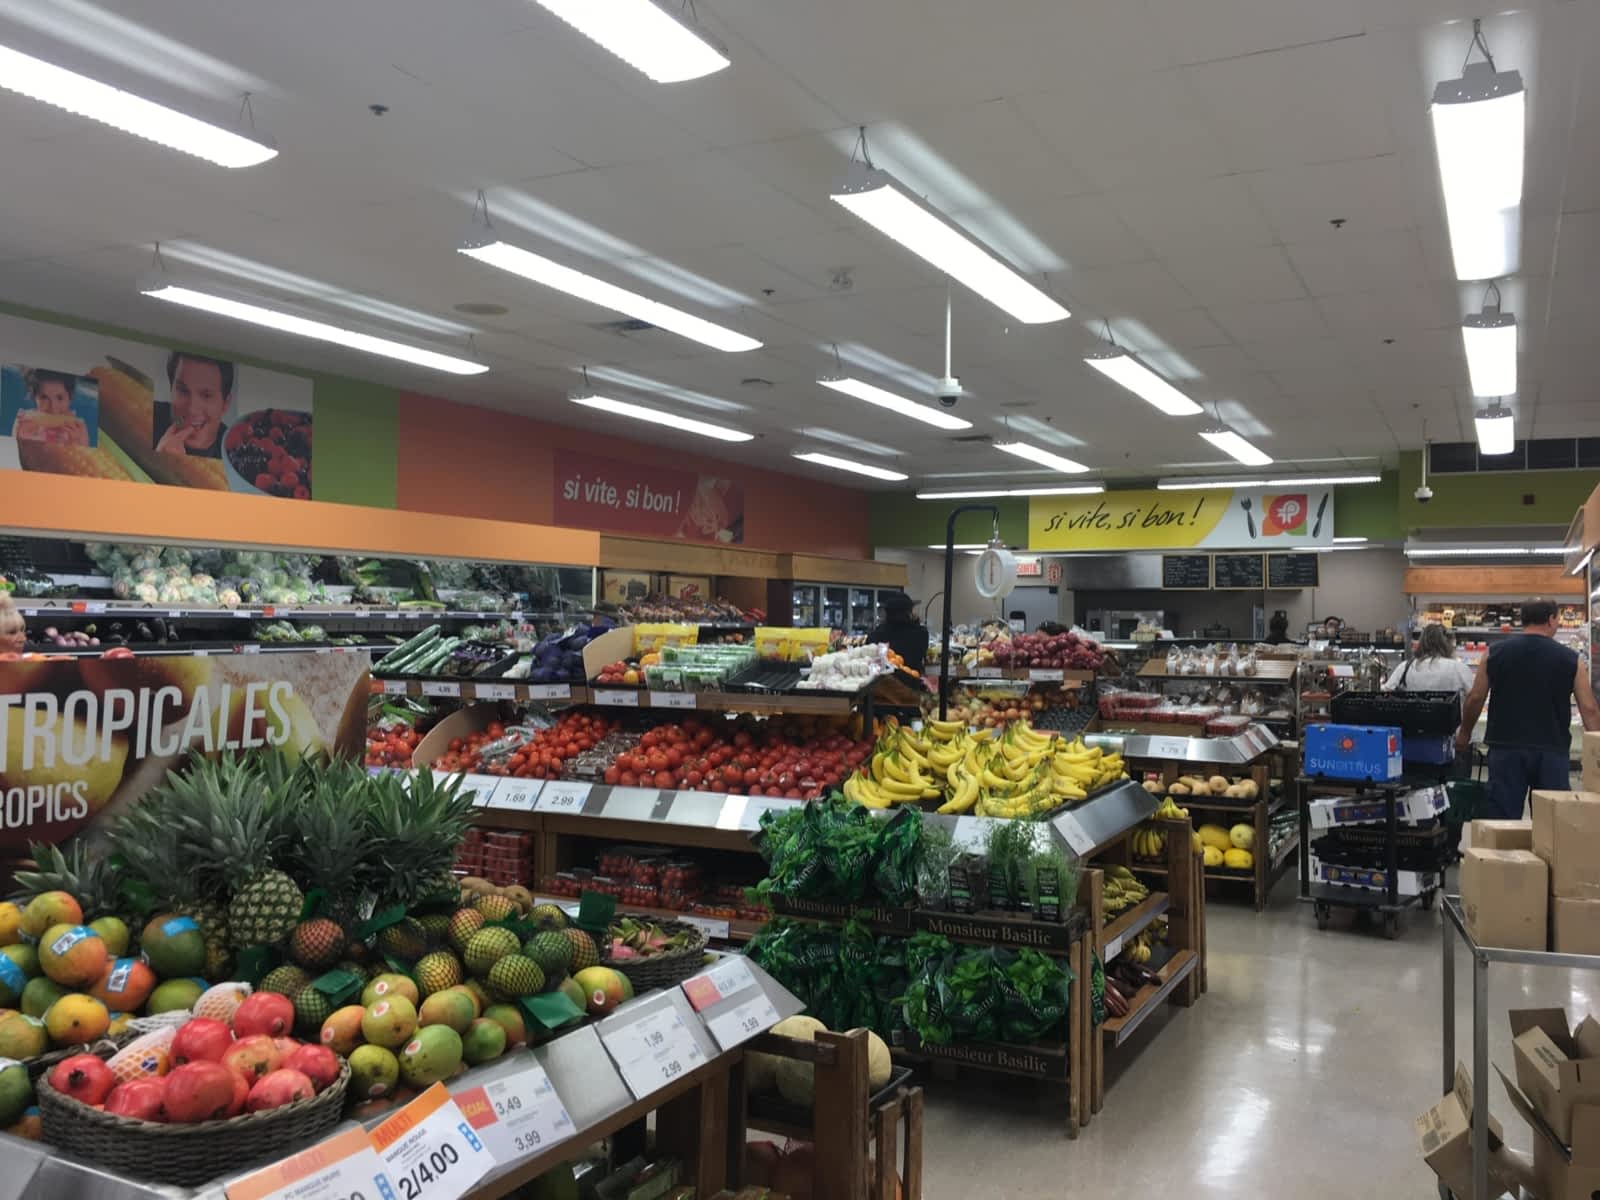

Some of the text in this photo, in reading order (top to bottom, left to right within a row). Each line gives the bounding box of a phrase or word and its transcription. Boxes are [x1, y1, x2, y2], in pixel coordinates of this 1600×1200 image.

[563, 474, 582, 500] si
[584, 477, 622, 509] vite,
[625, 484, 641, 508] si
[1044, 511, 1068, 532] si
[1115, 509, 1141, 529] si
[0, 681, 293, 773] TROPICALES
[928, 919, 1052, 945] Monsieur Basilic
[998, 1051, 1049, 1073] Basilic
[495, 1095, 522, 1116] 3,49
[514, 1130, 541, 1151] 3,99
